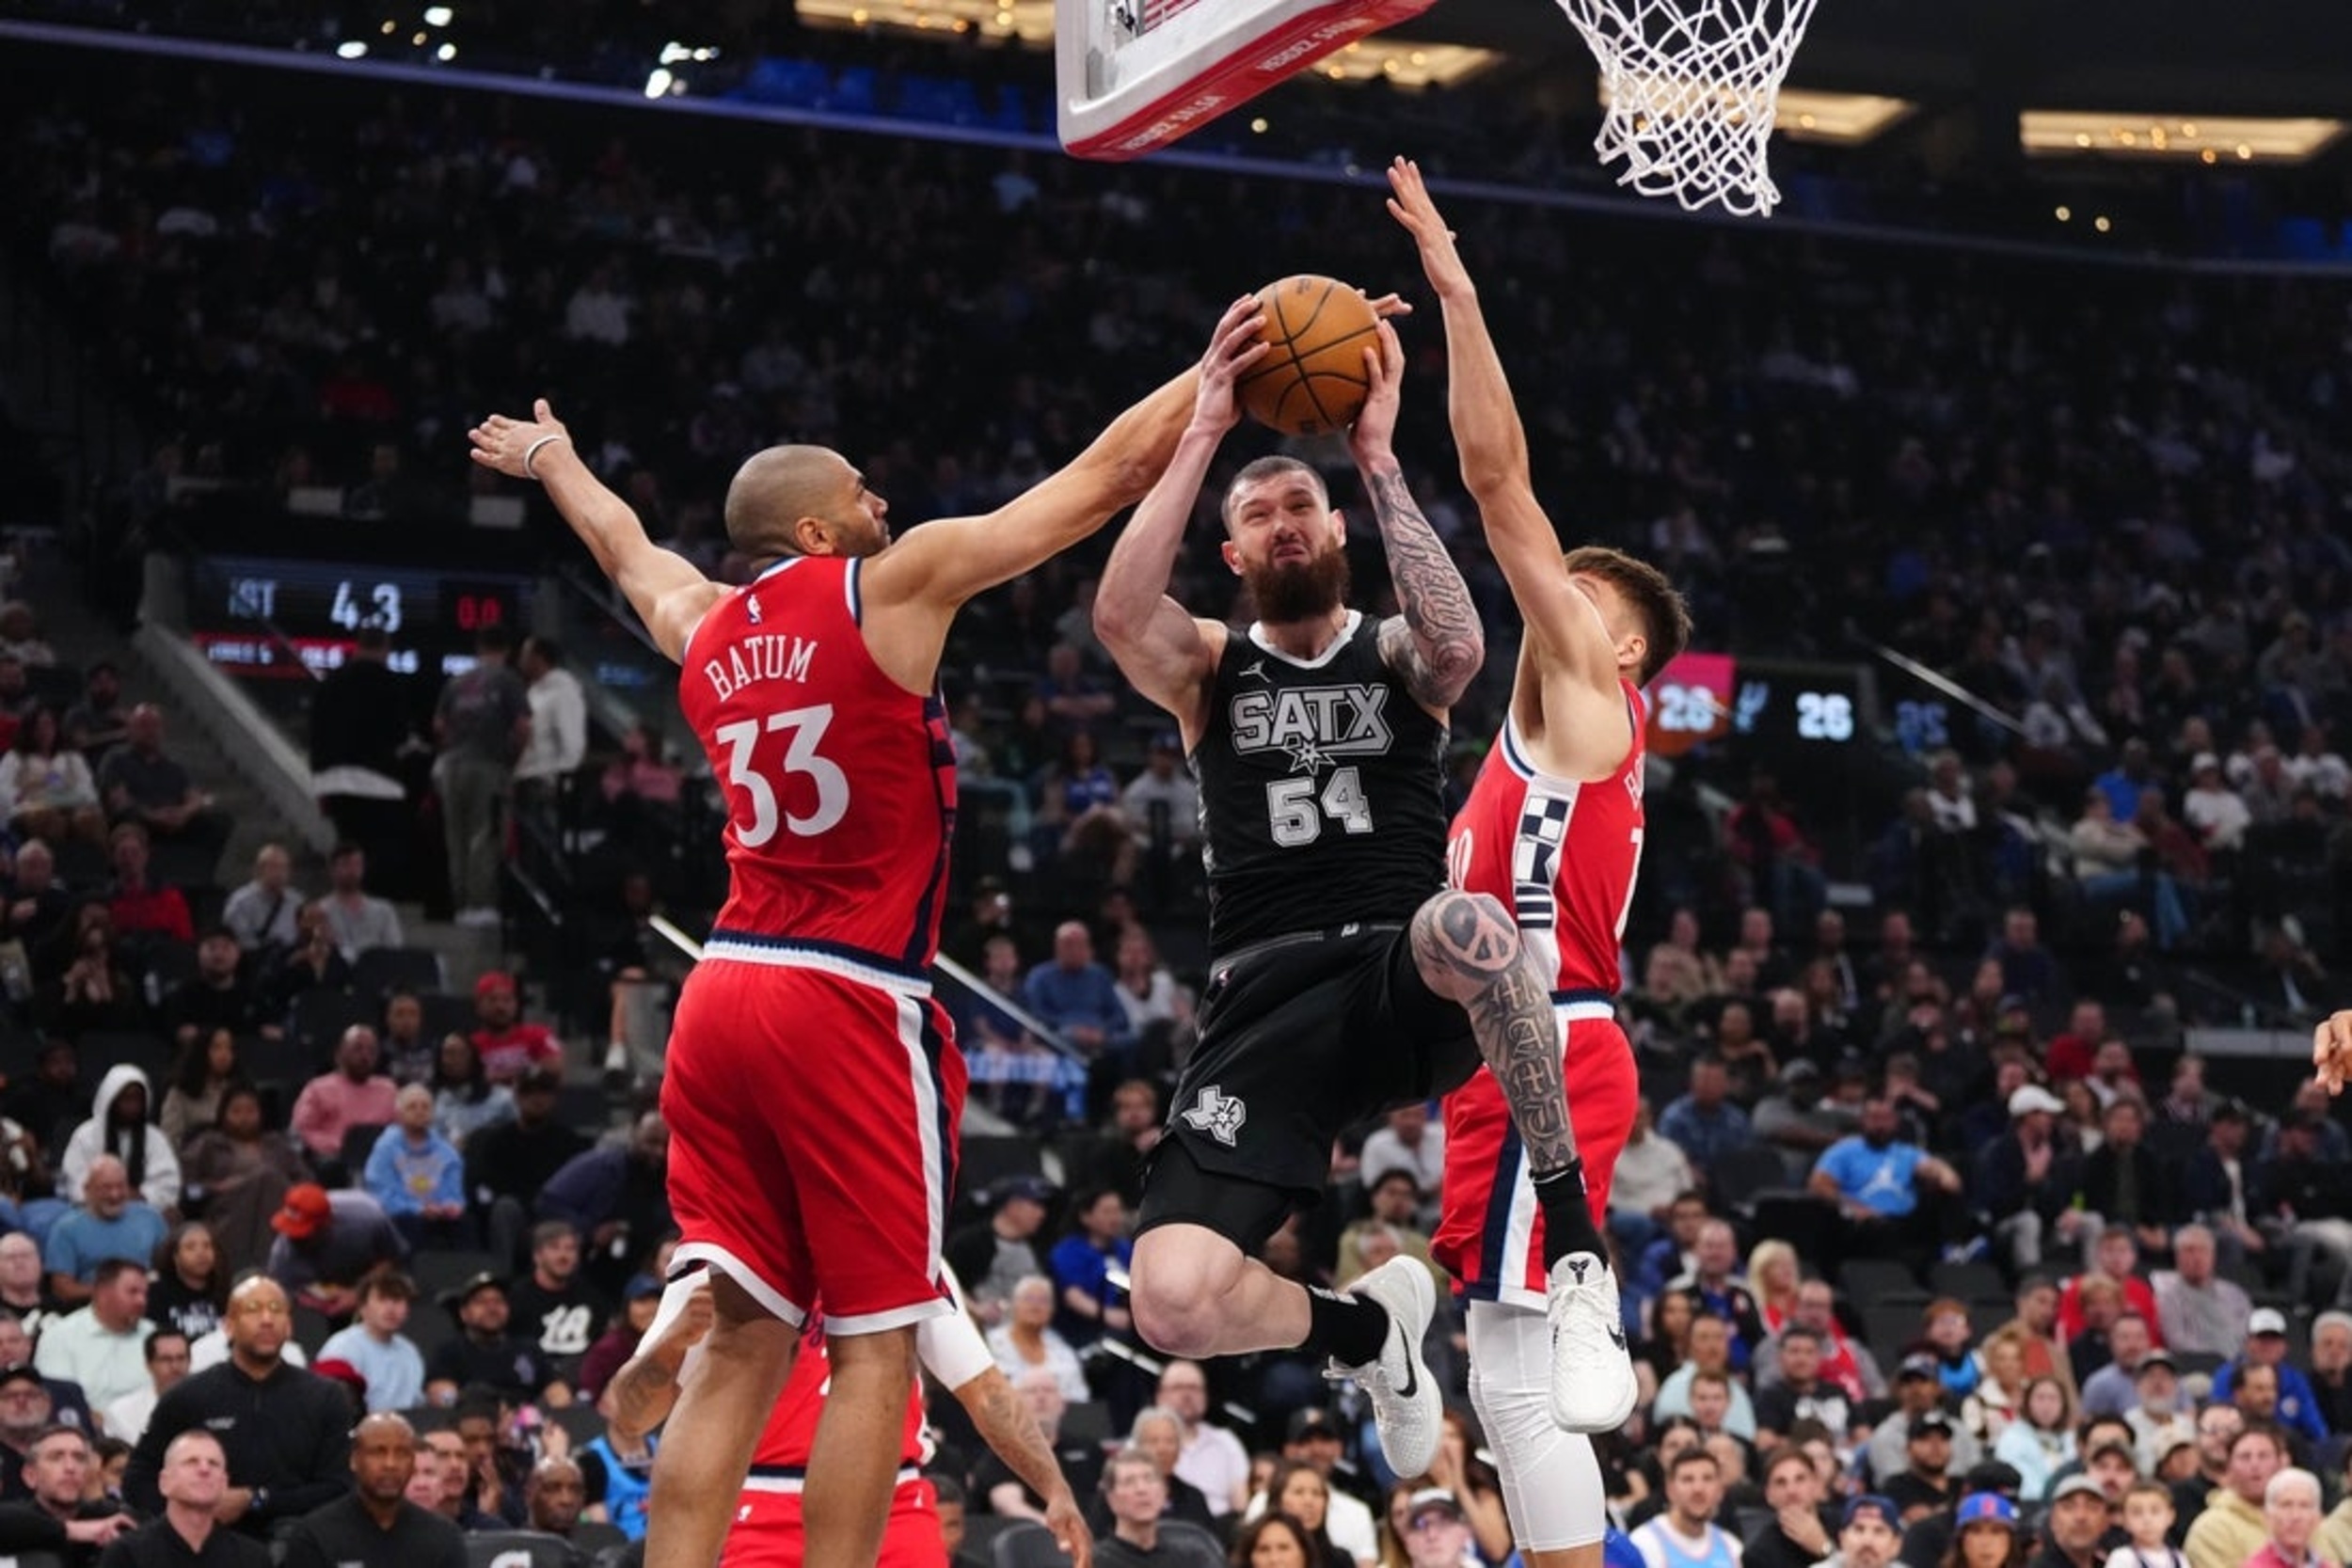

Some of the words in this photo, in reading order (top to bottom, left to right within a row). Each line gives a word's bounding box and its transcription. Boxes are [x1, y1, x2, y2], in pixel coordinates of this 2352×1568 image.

[705, 634, 817, 703] BATUM
[1230, 684, 1394, 756] SATX
[716, 703, 850, 847] 33
[1266, 766, 1374, 847] 54
